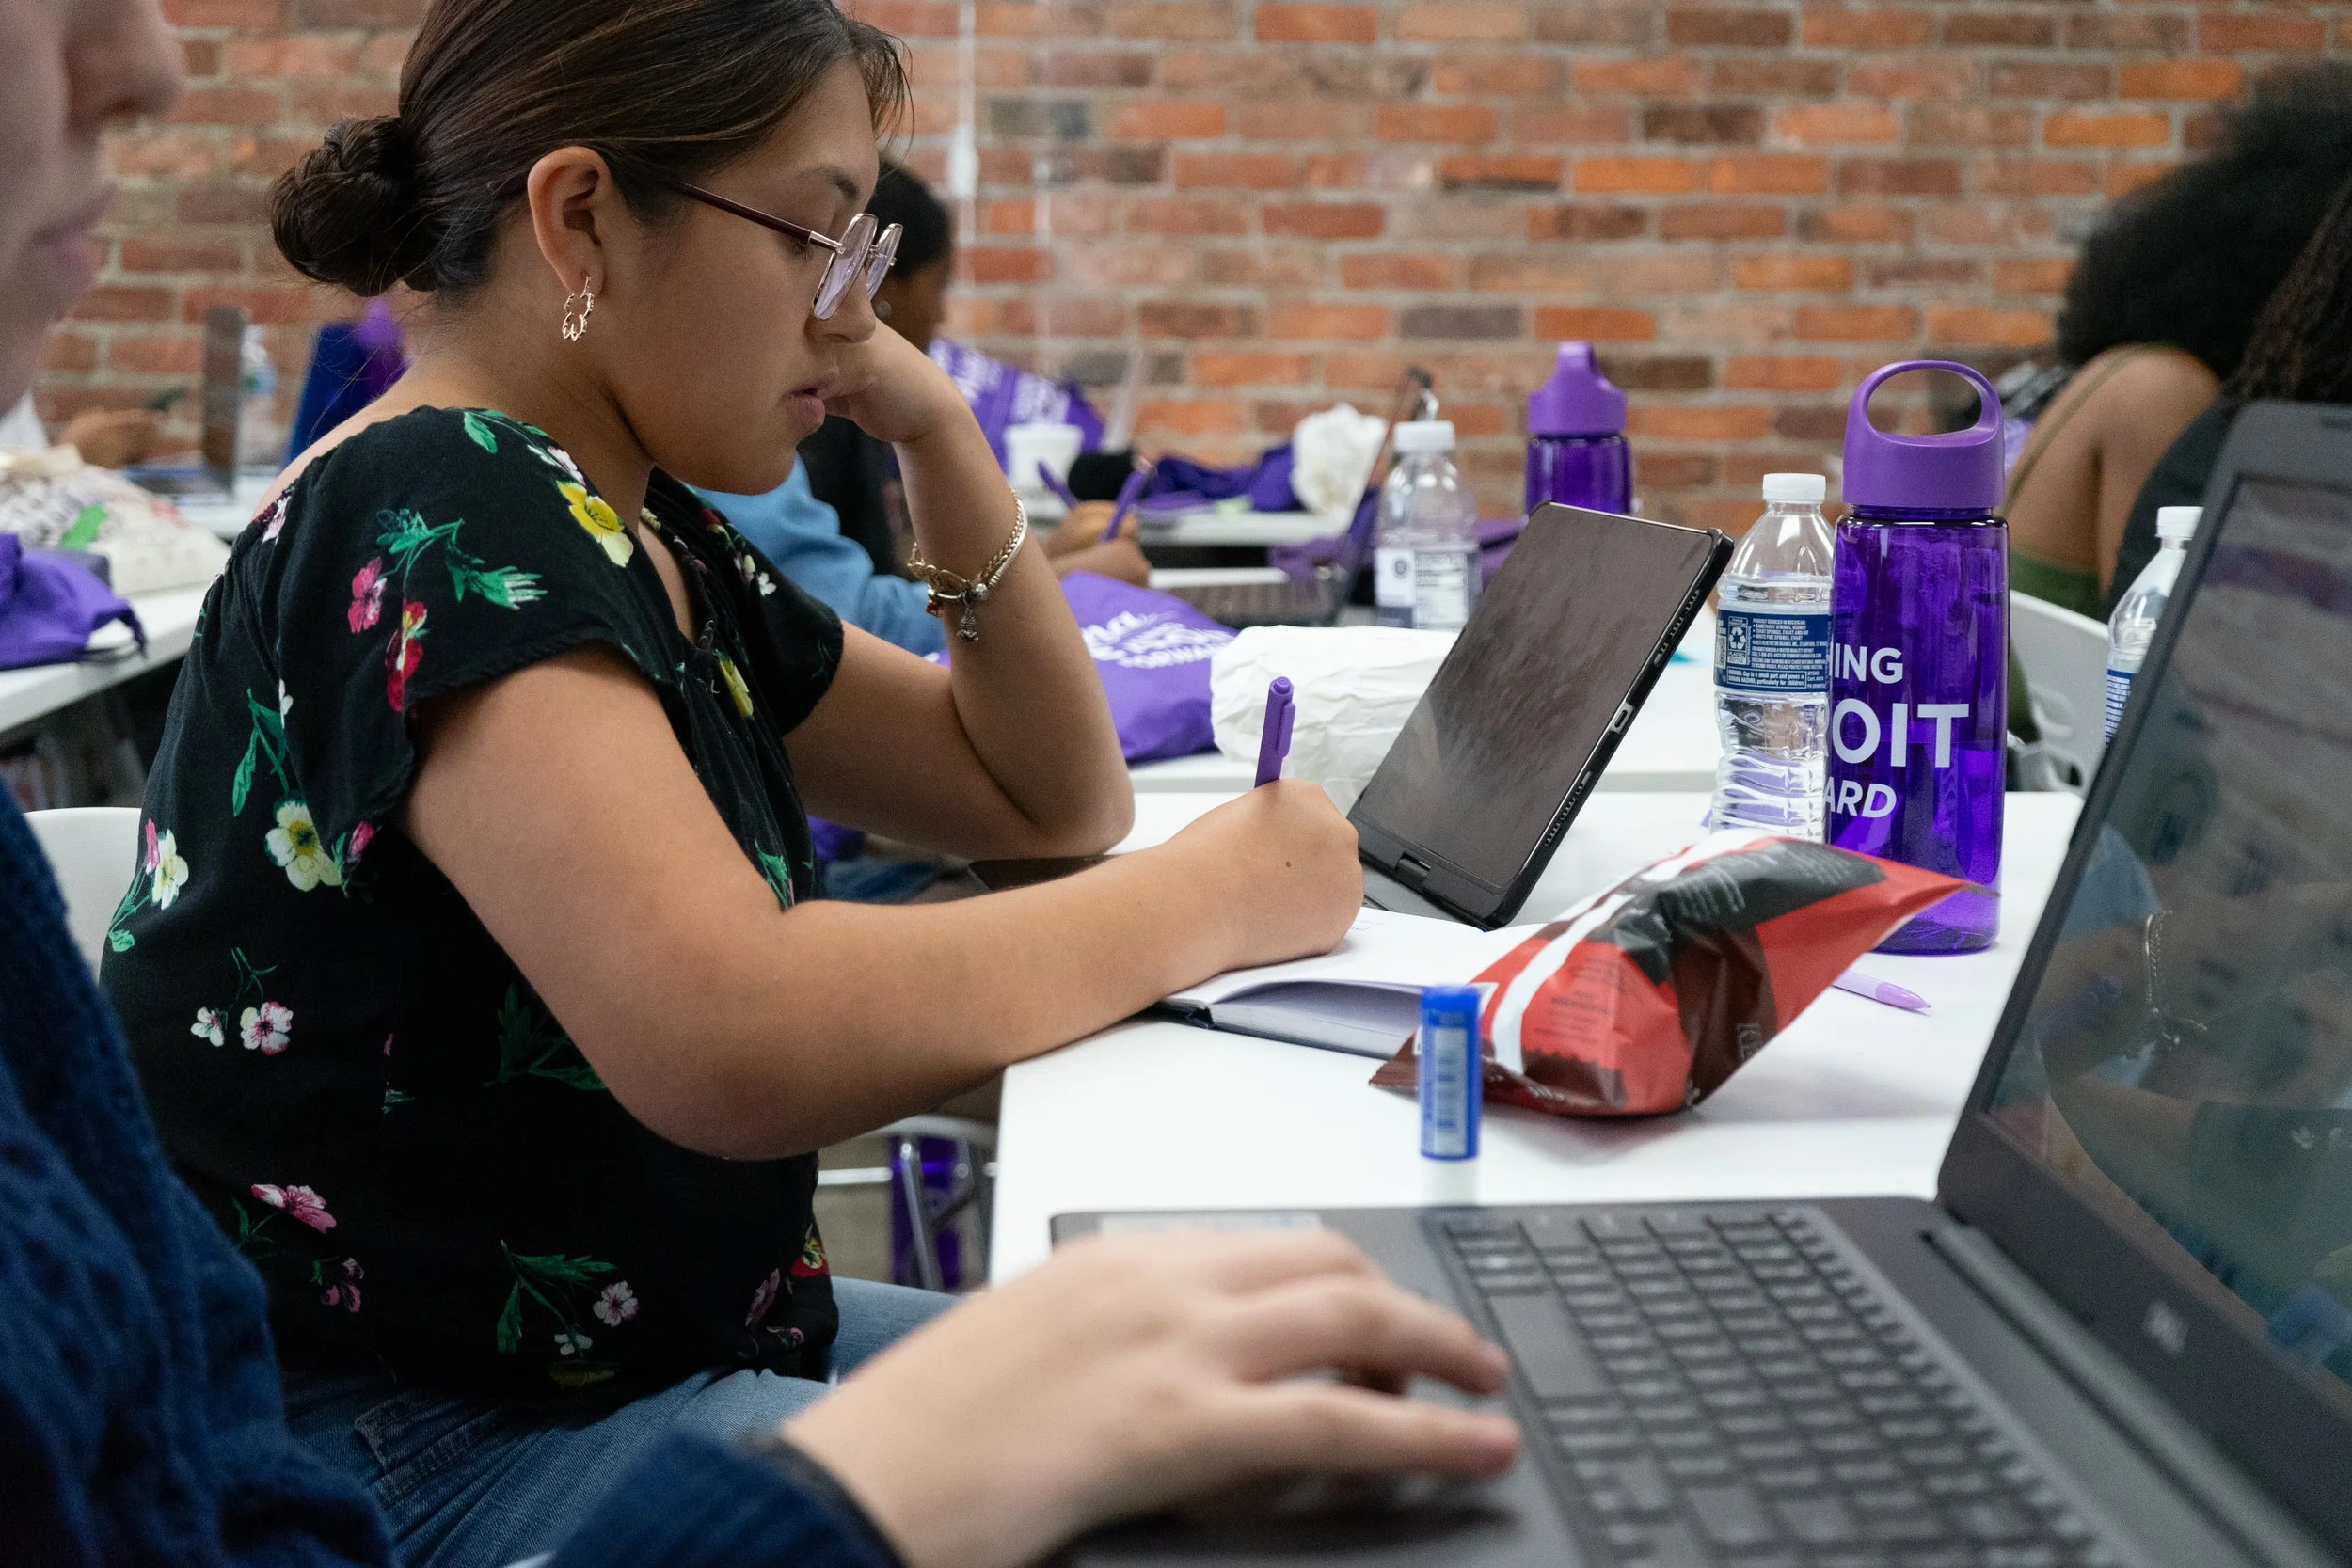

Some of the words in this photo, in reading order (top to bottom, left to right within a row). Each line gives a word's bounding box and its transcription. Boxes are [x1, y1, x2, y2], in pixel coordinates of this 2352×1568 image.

[1834, 643, 1904, 684] ING
[1832, 698, 1970, 768] OIT
[1823, 776, 1898, 818] ARD
